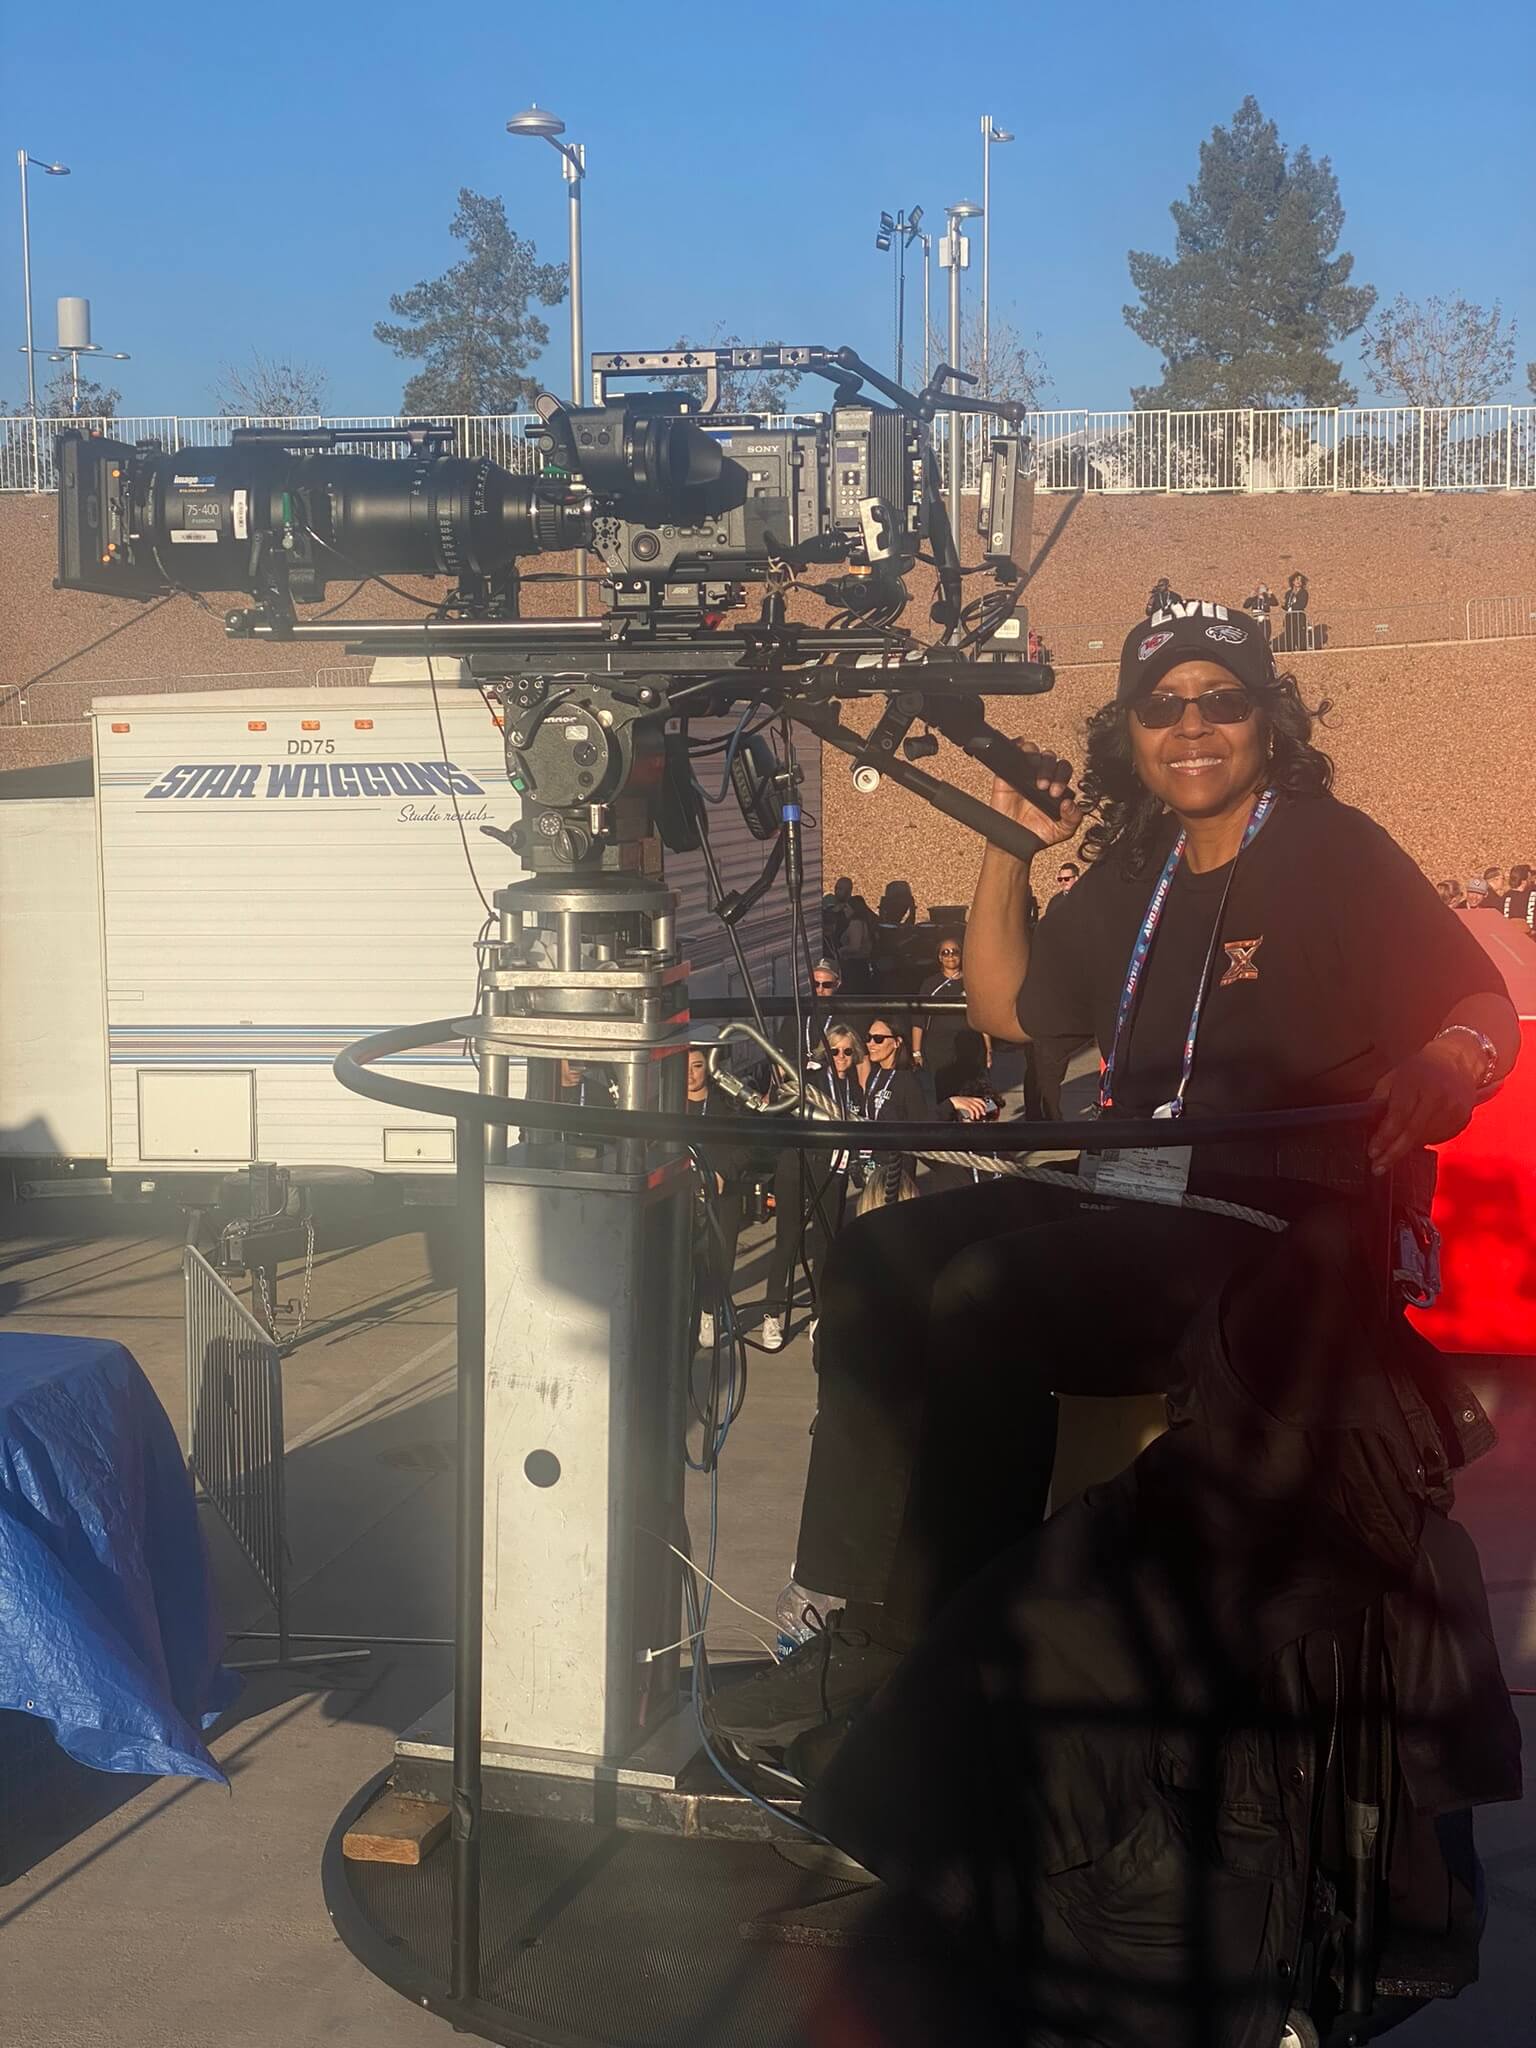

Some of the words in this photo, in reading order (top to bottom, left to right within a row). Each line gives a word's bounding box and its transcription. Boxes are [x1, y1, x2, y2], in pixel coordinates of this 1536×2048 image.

[747, 445, 779, 453] SONY
[186, 503, 220, 516] 75-400
[1151, 600, 1229, 627] LVII
[287, 739, 335, 755] DD75
[144, 764, 262, 799] STAR
[266, 761, 486, 798] WAGGONS
[397, 803, 442, 823] Studio
[445, 805, 494, 822] rentals
